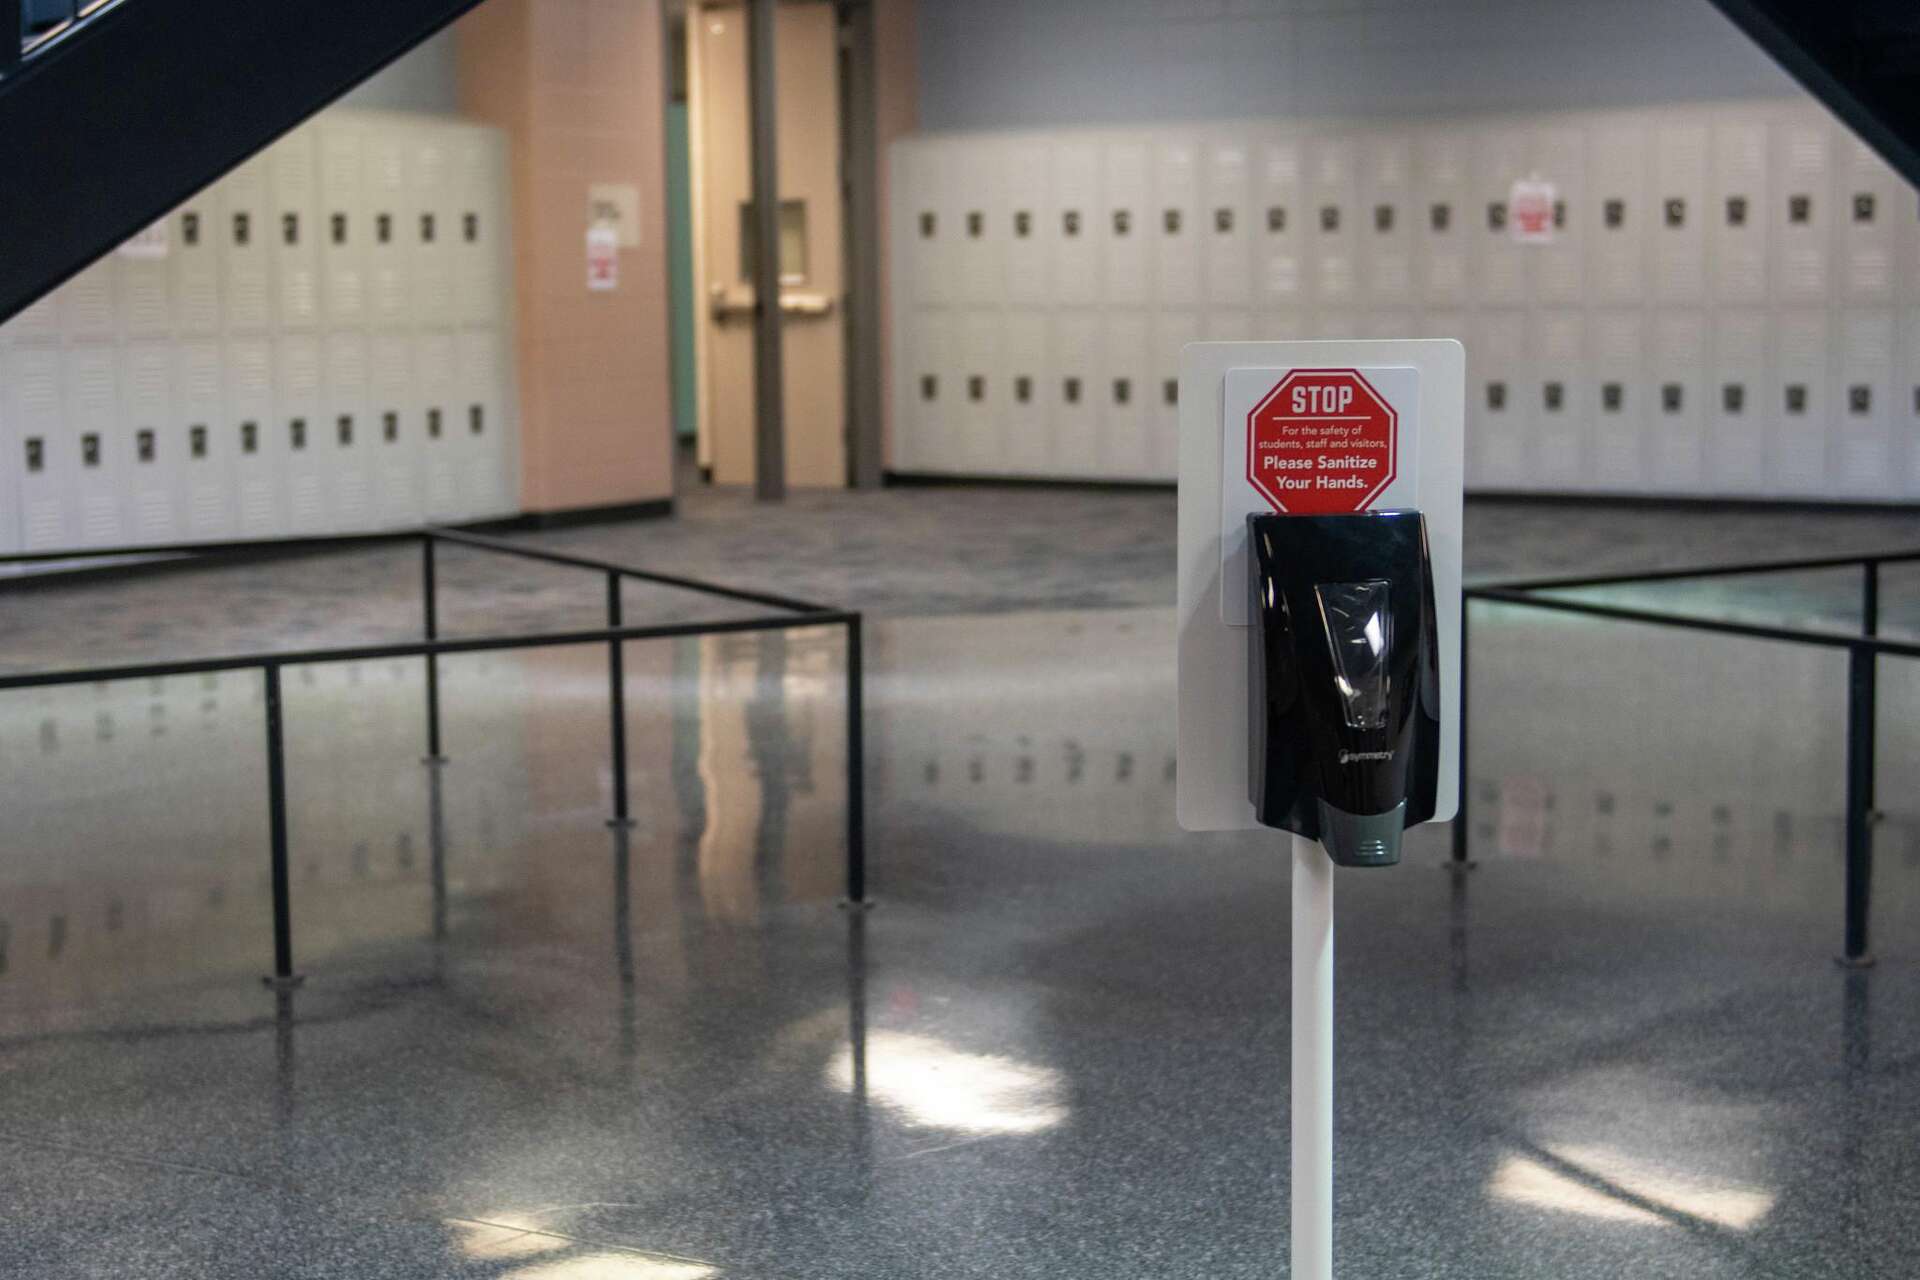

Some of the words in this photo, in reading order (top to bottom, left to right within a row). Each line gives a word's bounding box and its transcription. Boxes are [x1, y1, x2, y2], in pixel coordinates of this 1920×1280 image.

[1292, 386, 1353, 413] STOP
[1282, 426, 1299, 436] For
[1301, 426, 1318, 436] the
[1320, 425, 1349, 438] safety
[1351, 425, 1362, 436] of
[1306, 438, 1328, 449] staff
[1330, 438, 1348, 449] and
[1264, 456, 1313, 469] Please
[1317, 455, 1377, 470] Sanitize
[1276, 475, 1311, 489] Your
[1316, 475, 1368, 489] Hands.
